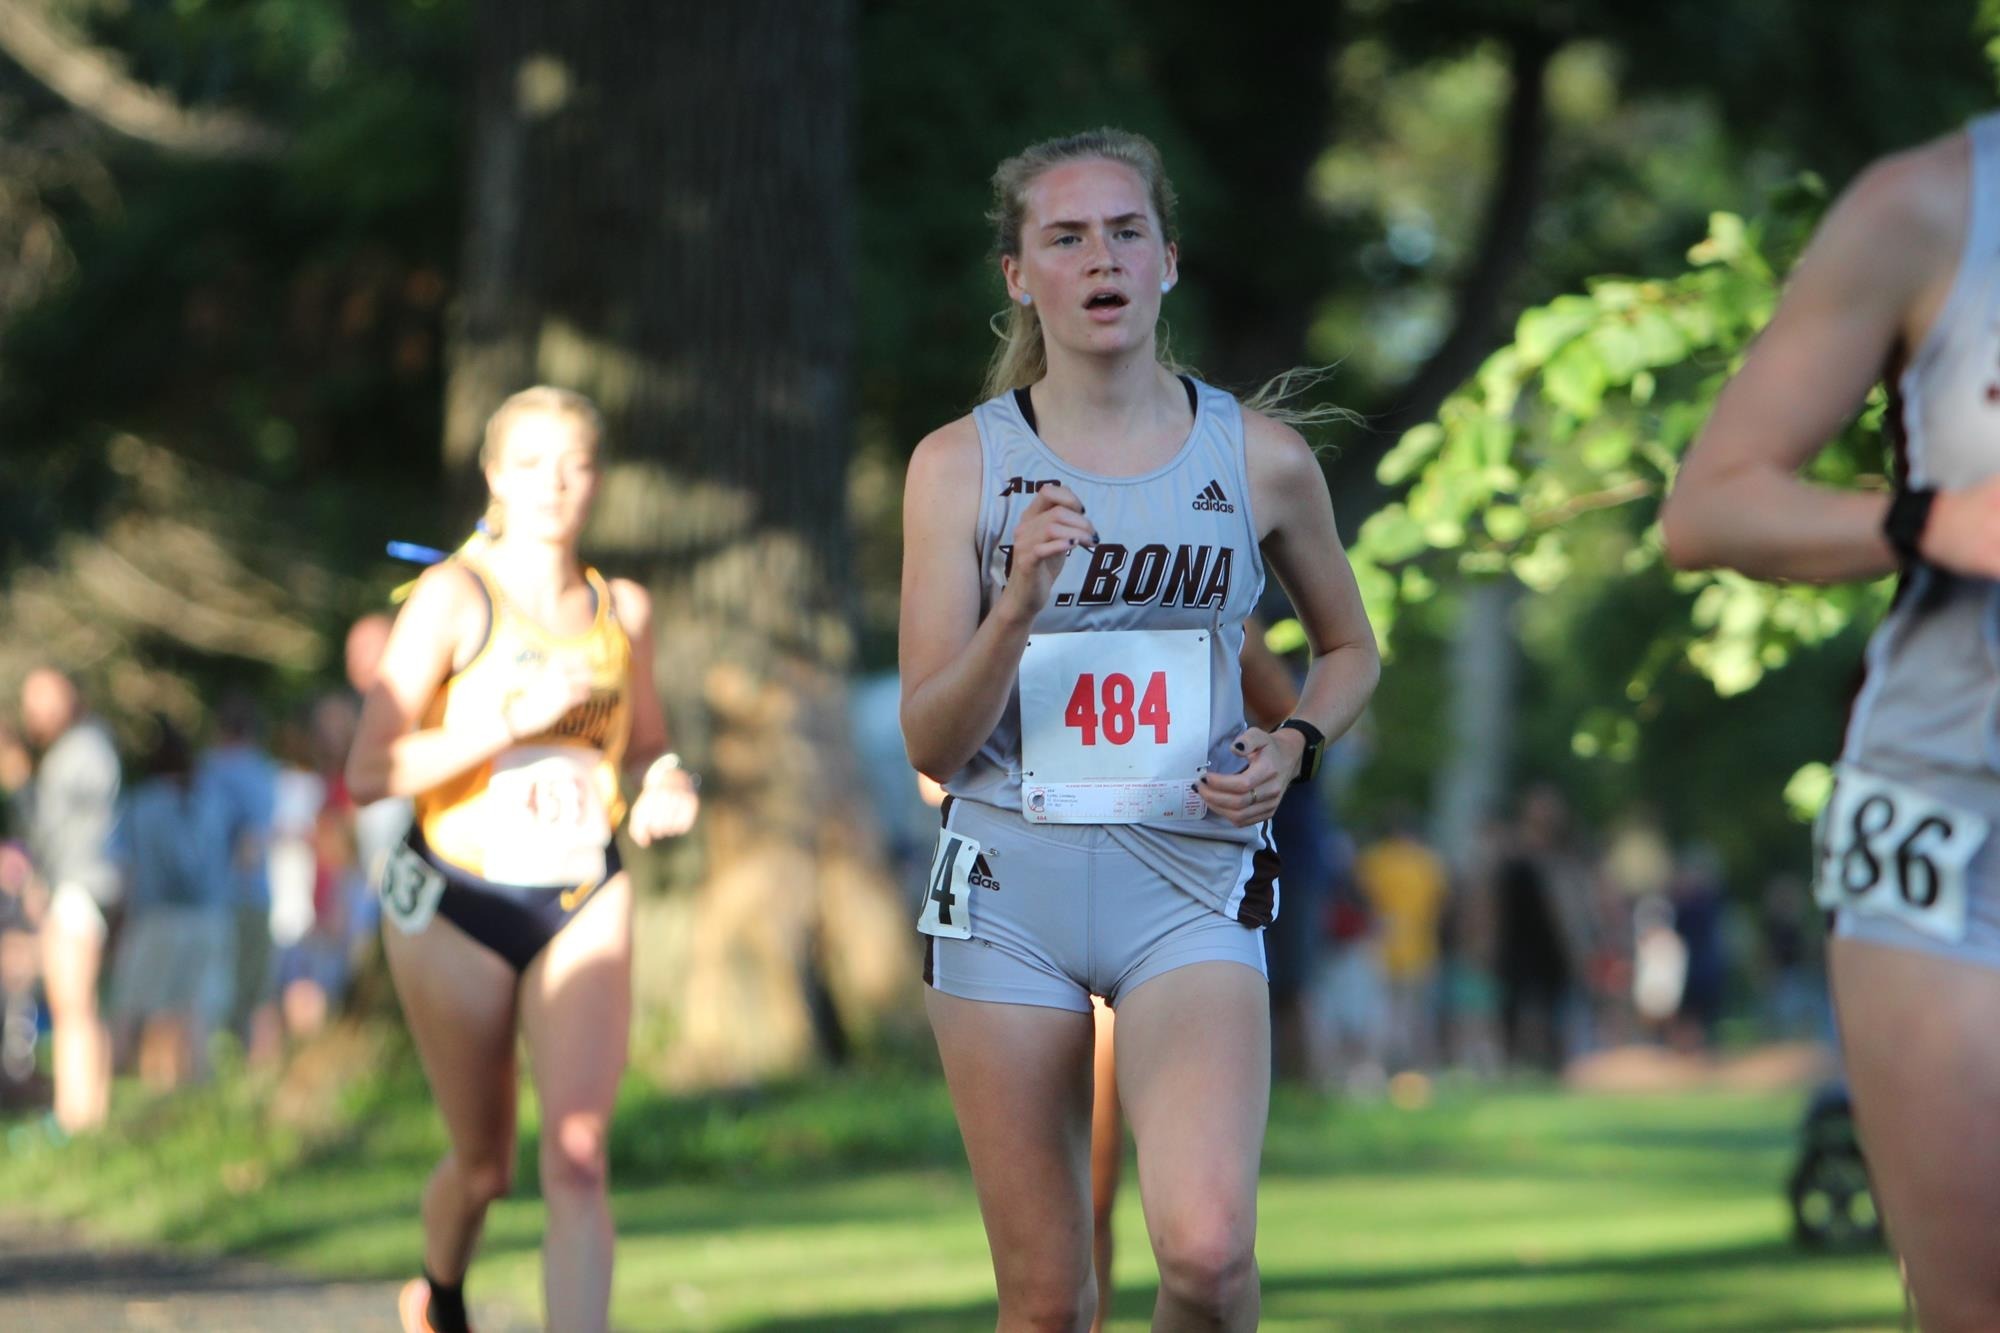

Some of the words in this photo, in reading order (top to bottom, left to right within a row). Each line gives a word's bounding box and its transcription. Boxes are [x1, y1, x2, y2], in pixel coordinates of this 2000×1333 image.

[1192, 499, 1234, 514] adidas
[999, 544, 1234, 611] .BONA
[1065, 671, 1171, 745] 484
[930, 837, 956, 926] 4
[967, 873, 1001, 891] idas
[1822, 794, 1953, 909] 86
